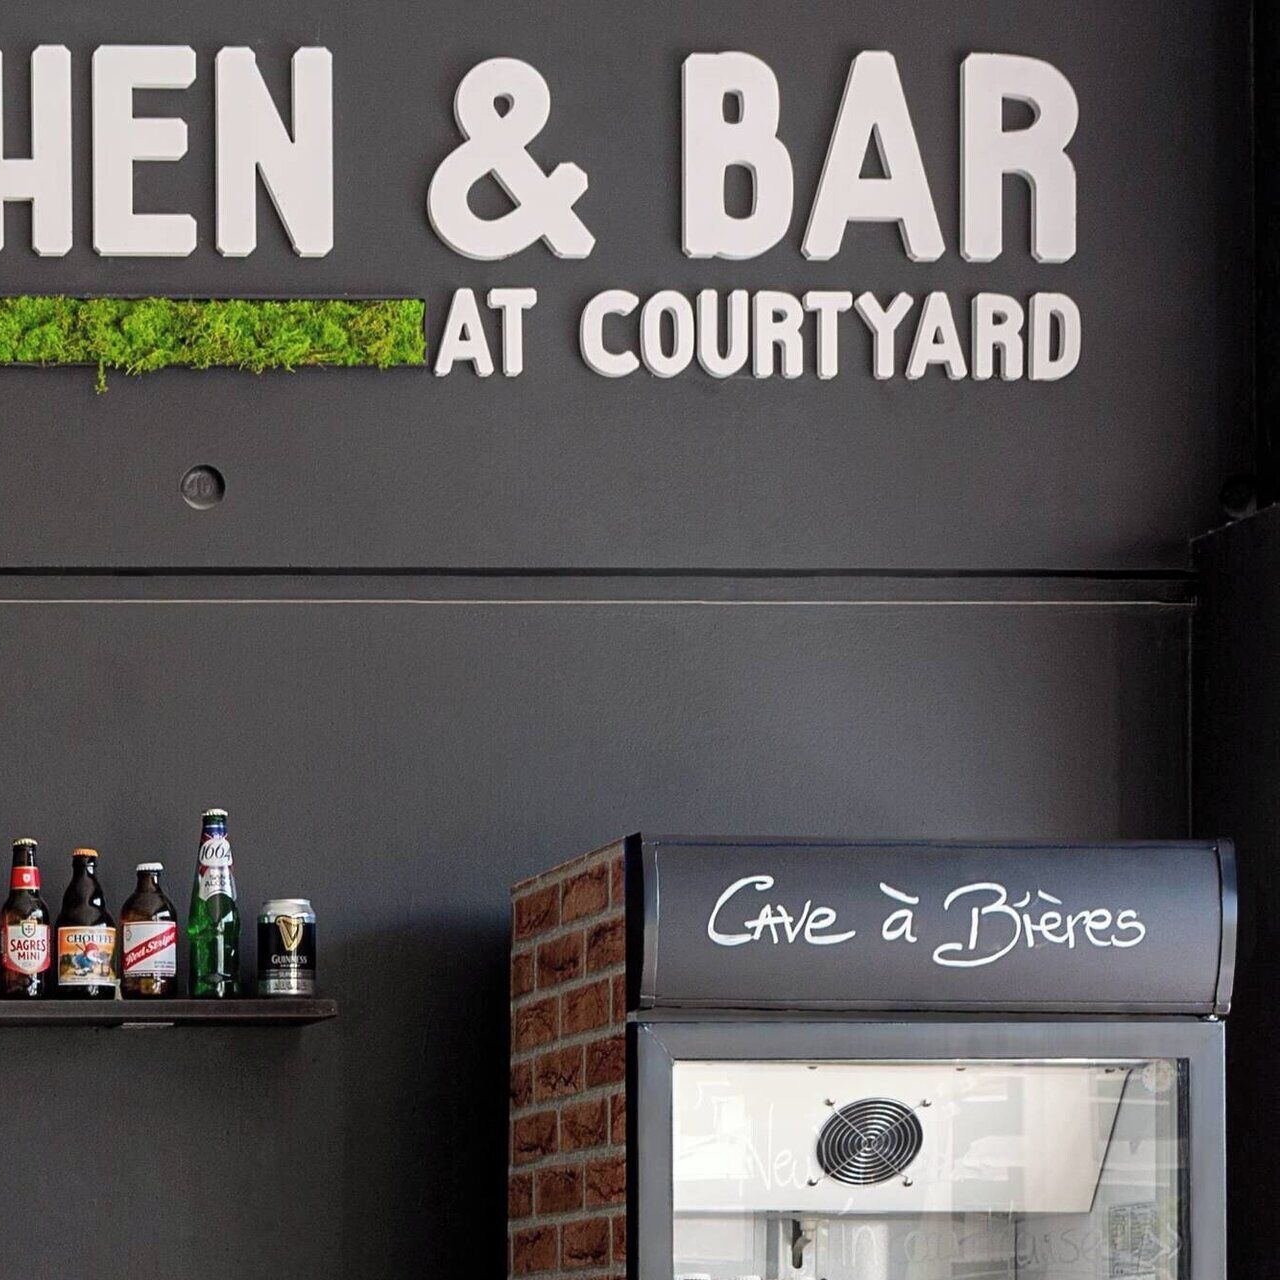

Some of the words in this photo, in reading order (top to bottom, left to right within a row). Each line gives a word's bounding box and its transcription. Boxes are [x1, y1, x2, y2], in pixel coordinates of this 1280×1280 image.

[428, 56, 596, 260] &
[680, 49, 1080, 263] BAR
[435, 286, 537, 380] AT
[579, 288, 1085, 383] COURTYARD
[10, 938, 46, 952] SAGRES
[879, 881, 920, 943] à
[932, 881, 1147, 968] Bières
[124, 949, 146, 966] Red
[271, 953, 308, 965] GUINNESS
